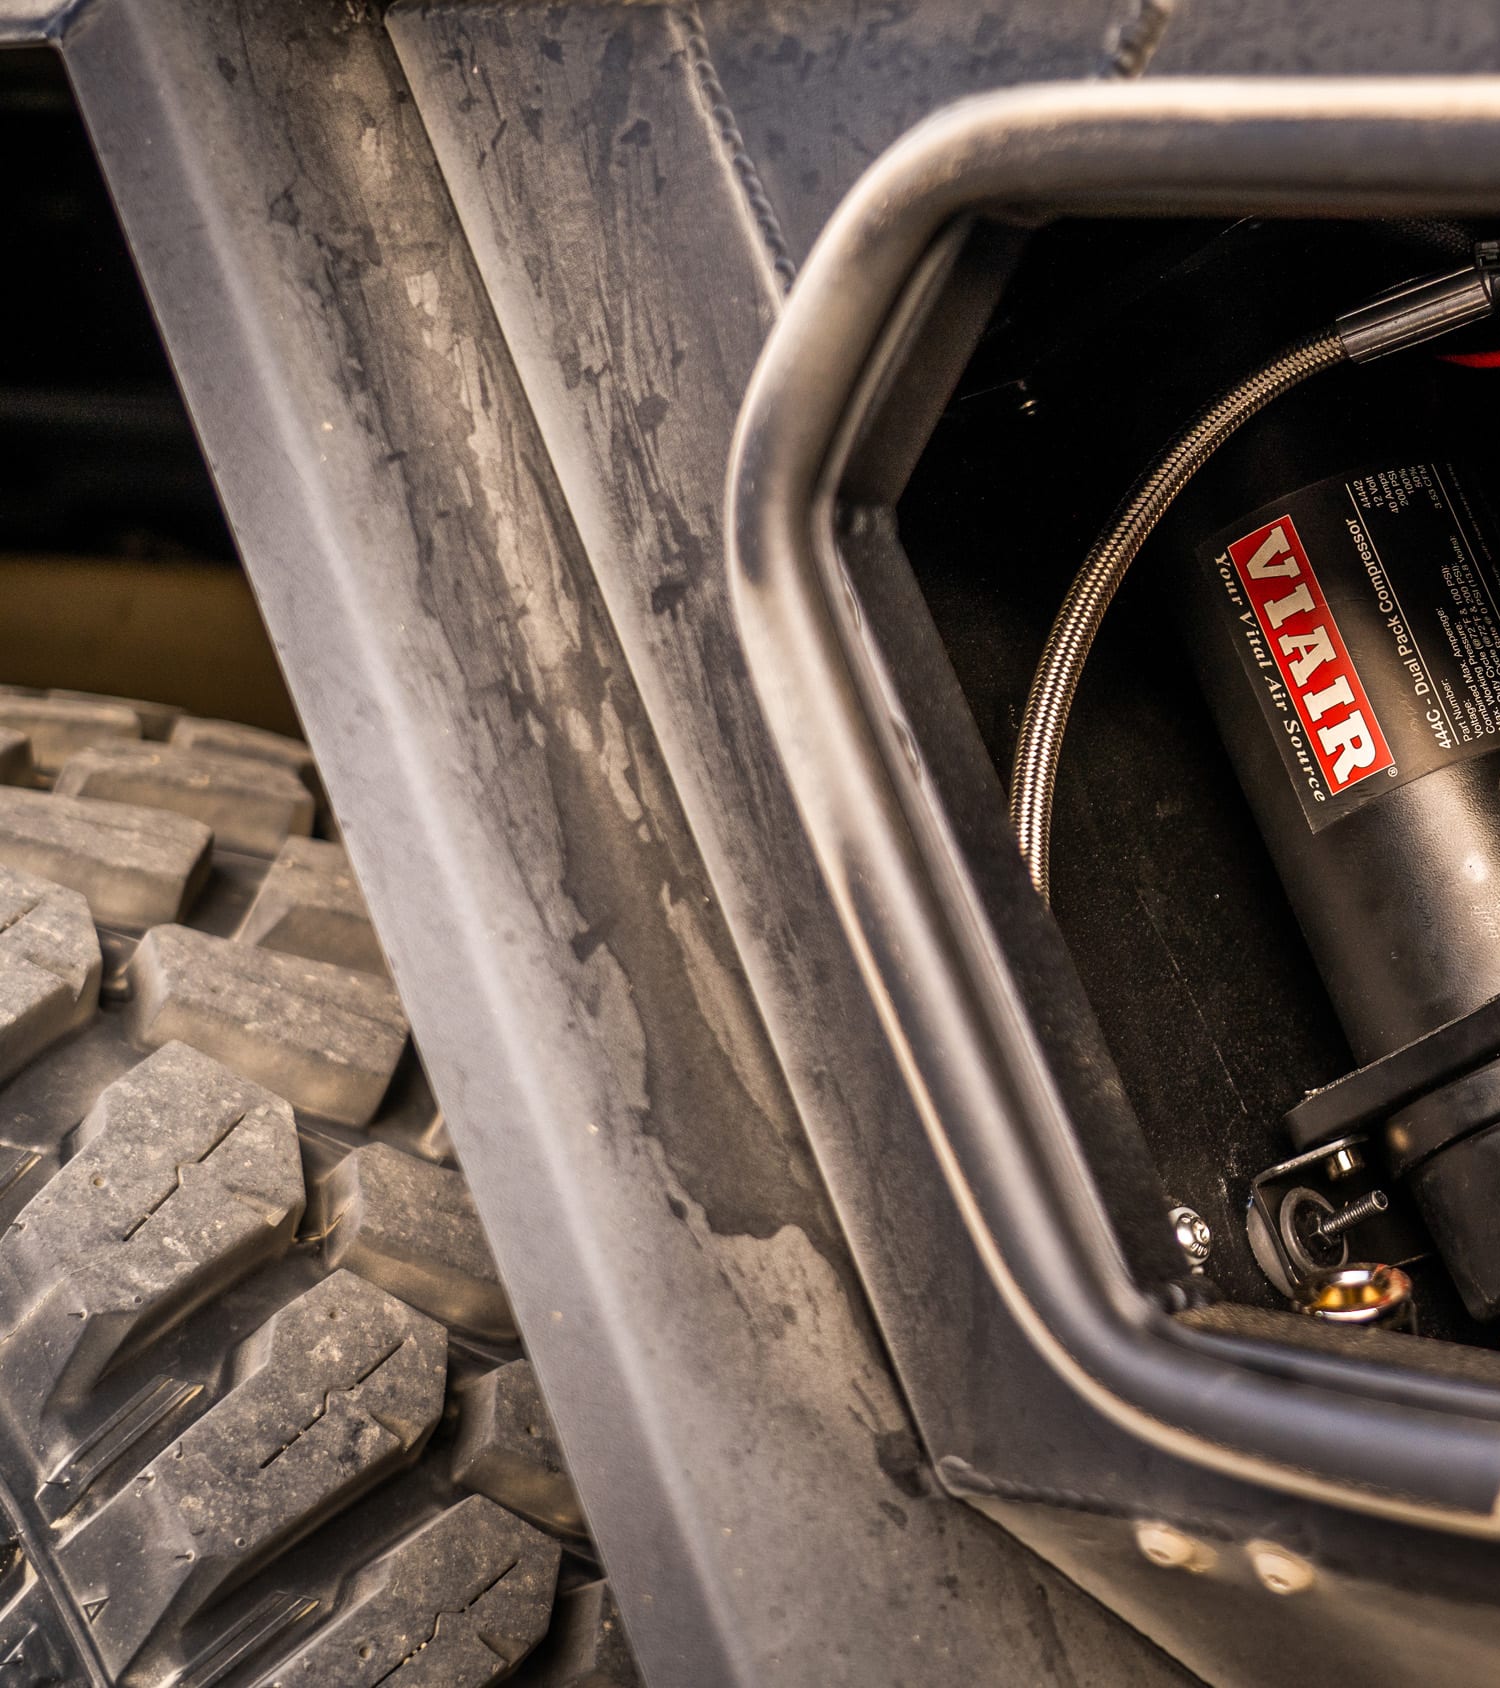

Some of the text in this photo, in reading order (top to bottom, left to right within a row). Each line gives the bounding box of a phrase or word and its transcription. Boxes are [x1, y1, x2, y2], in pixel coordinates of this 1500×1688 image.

[1352, 479, 1372, 509] 44442
[1364, 475, 1385, 508] 12 Volt
[1377, 472, 1395, 500] Amps
[1386, 470, 1409, 507] 200 PSI
[1397, 468, 1415, 495] 100%
[1407, 466, 1424, 488] 50%
[1345, 518, 1394, 613] Compressor
[1450, 587, 1464, 606] 100
[1460, 585, 1475, 605] 200
[1471, 589, 1485, 606] PSI
[1246, 525, 1377, 785] VIAIR
[1386, 614, 1413, 657] Pack
[1454, 621, 1479, 666] Pressure:
[1214, 551, 1326, 802] Your Vital Air Source
[1403, 657, 1430, 696] Dual
[1435, 607, 1496, 735] Combined Max. Amperage:
[1479, 651, 1496, 679] Cycle
[1473, 666, 1496, 706] Working
[1425, 708, 1452, 749] 444C
[1440, 678, 1473, 742] Part Number:
[1463, 698, 1484, 739] Voltage:
